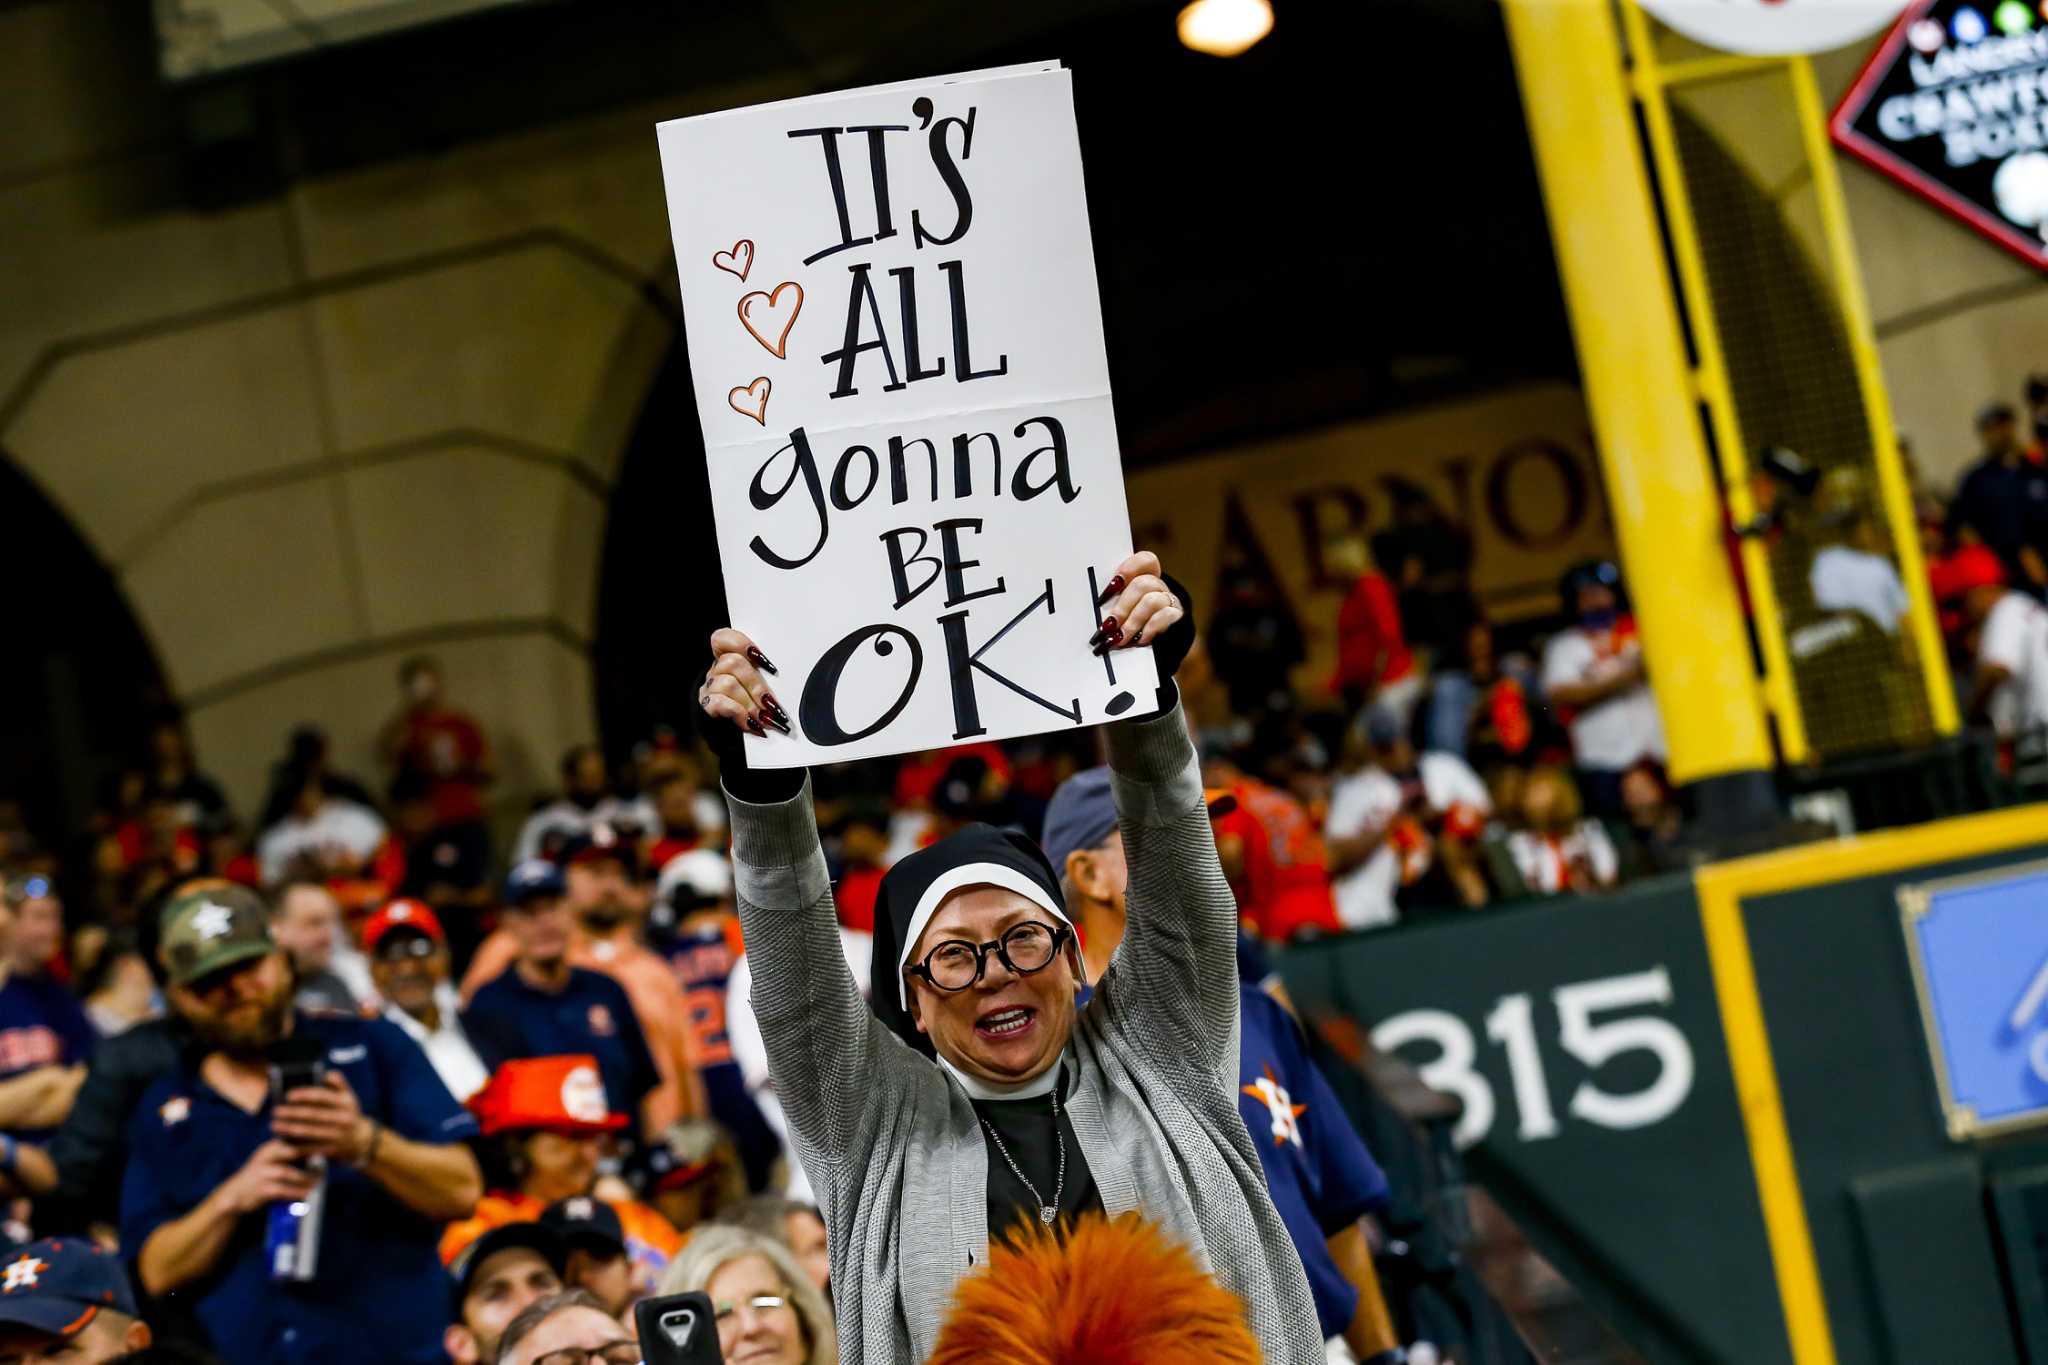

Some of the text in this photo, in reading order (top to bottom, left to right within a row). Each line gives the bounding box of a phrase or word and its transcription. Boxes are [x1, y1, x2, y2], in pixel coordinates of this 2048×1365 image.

[786, 95, 978, 267] IT'S
[820, 260, 1009, 400] ALL
[748, 415, 1083, 570] gonna
[878, 517, 1007, 610] BE
[798, 566, 1136, 747] OK!
[1370, 964, 1695, 1151] 315
